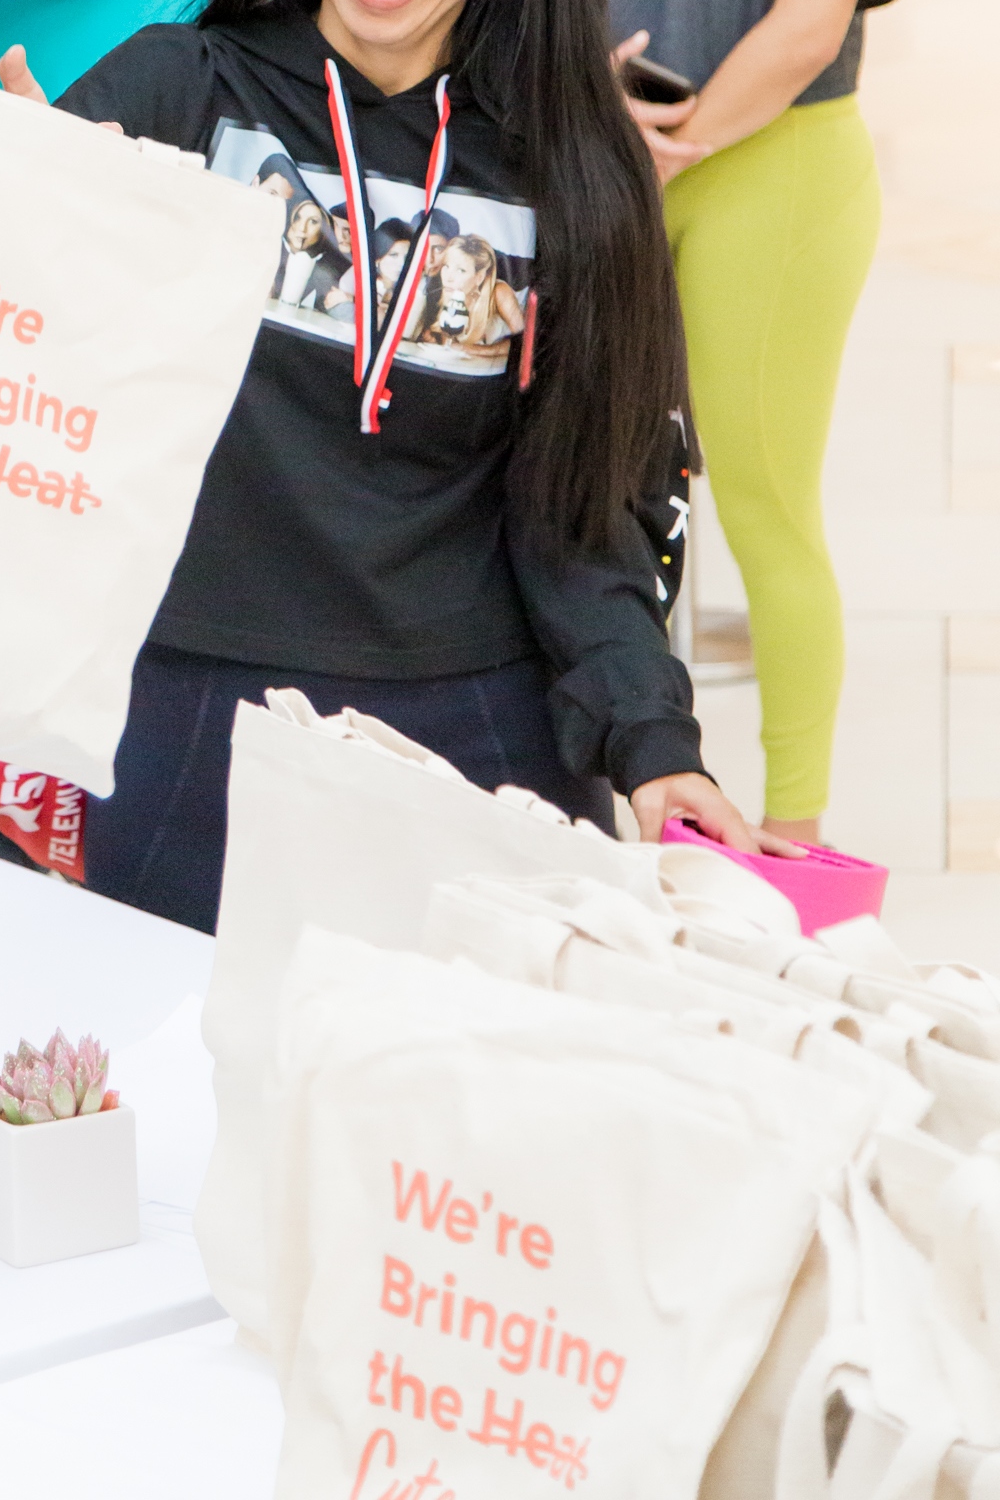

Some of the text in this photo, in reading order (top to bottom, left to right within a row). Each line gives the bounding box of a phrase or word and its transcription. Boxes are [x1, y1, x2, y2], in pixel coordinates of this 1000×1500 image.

[391, 1160, 555, 1270] We're
[379, 1253, 626, 1412] Bringing
[368, 1349, 464, 1432] the
